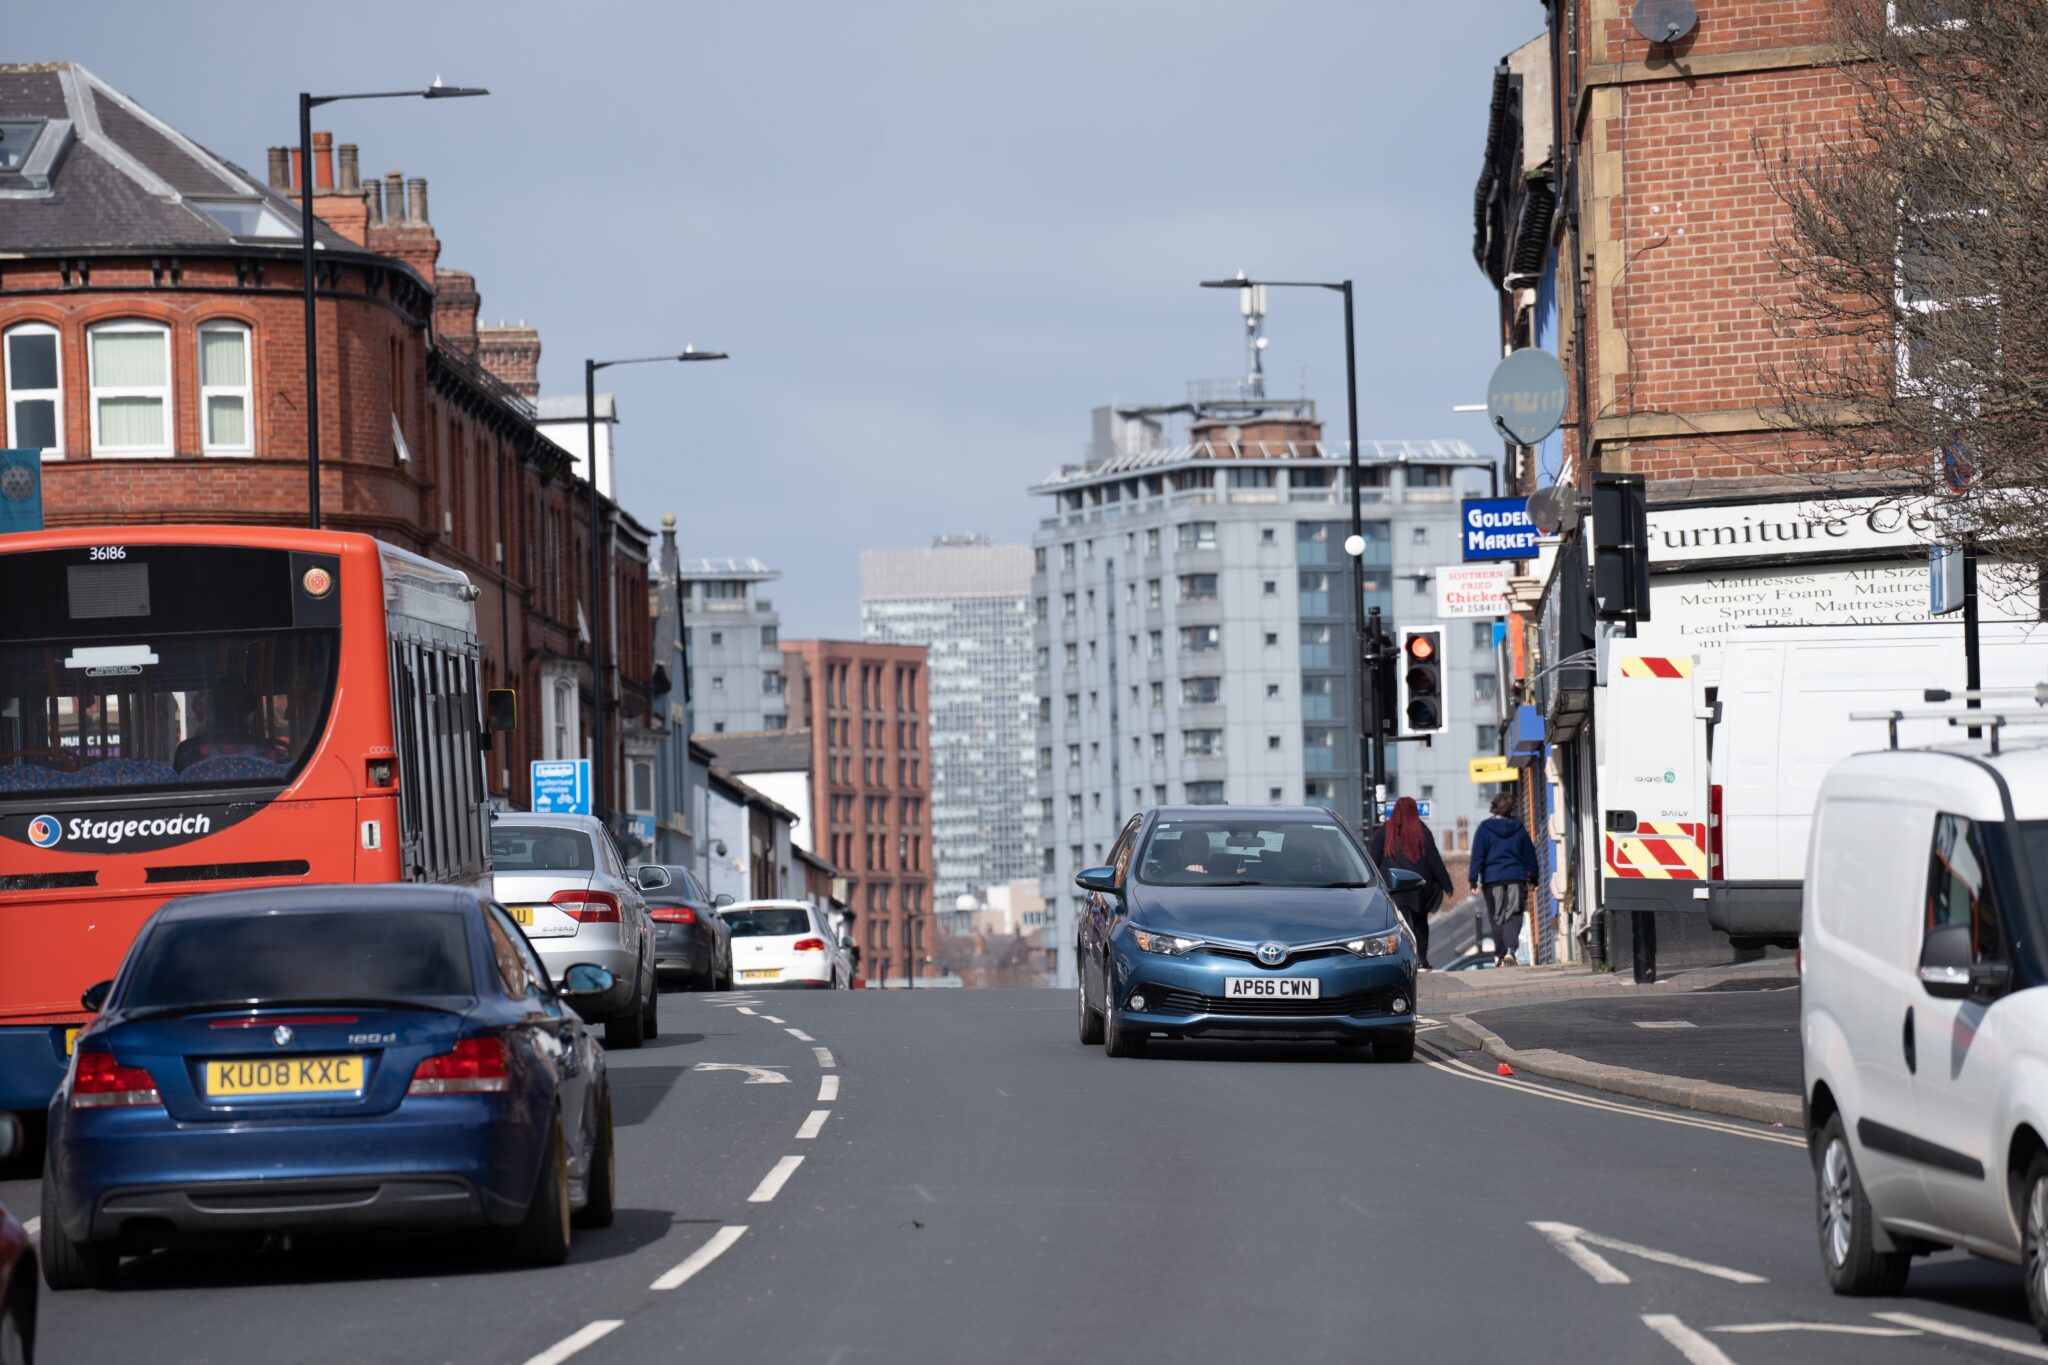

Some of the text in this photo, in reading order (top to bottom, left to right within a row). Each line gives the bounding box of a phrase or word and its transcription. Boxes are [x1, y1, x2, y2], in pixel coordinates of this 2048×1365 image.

[1468, 508, 1533, 528] GOLDEN
[1468, 531, 1535, 551] MARKET
[89, 546, 127, 561] 36186
[1706, 575, 1816, 590] Mattresses
[1844, 567, 1876, 581] All
[1884, 566, 1929, 579] Size
[1680, 582, 1931, 607] Memory Foam Mattres
[1719, 598, 1926, 620] Sprung Mattresses
[67, 813, 211, 844] Stagecoach
[1233, 980, 1312, 996] AP66 CWN
[220, 1060, 351, 1088] KU08 KXC
